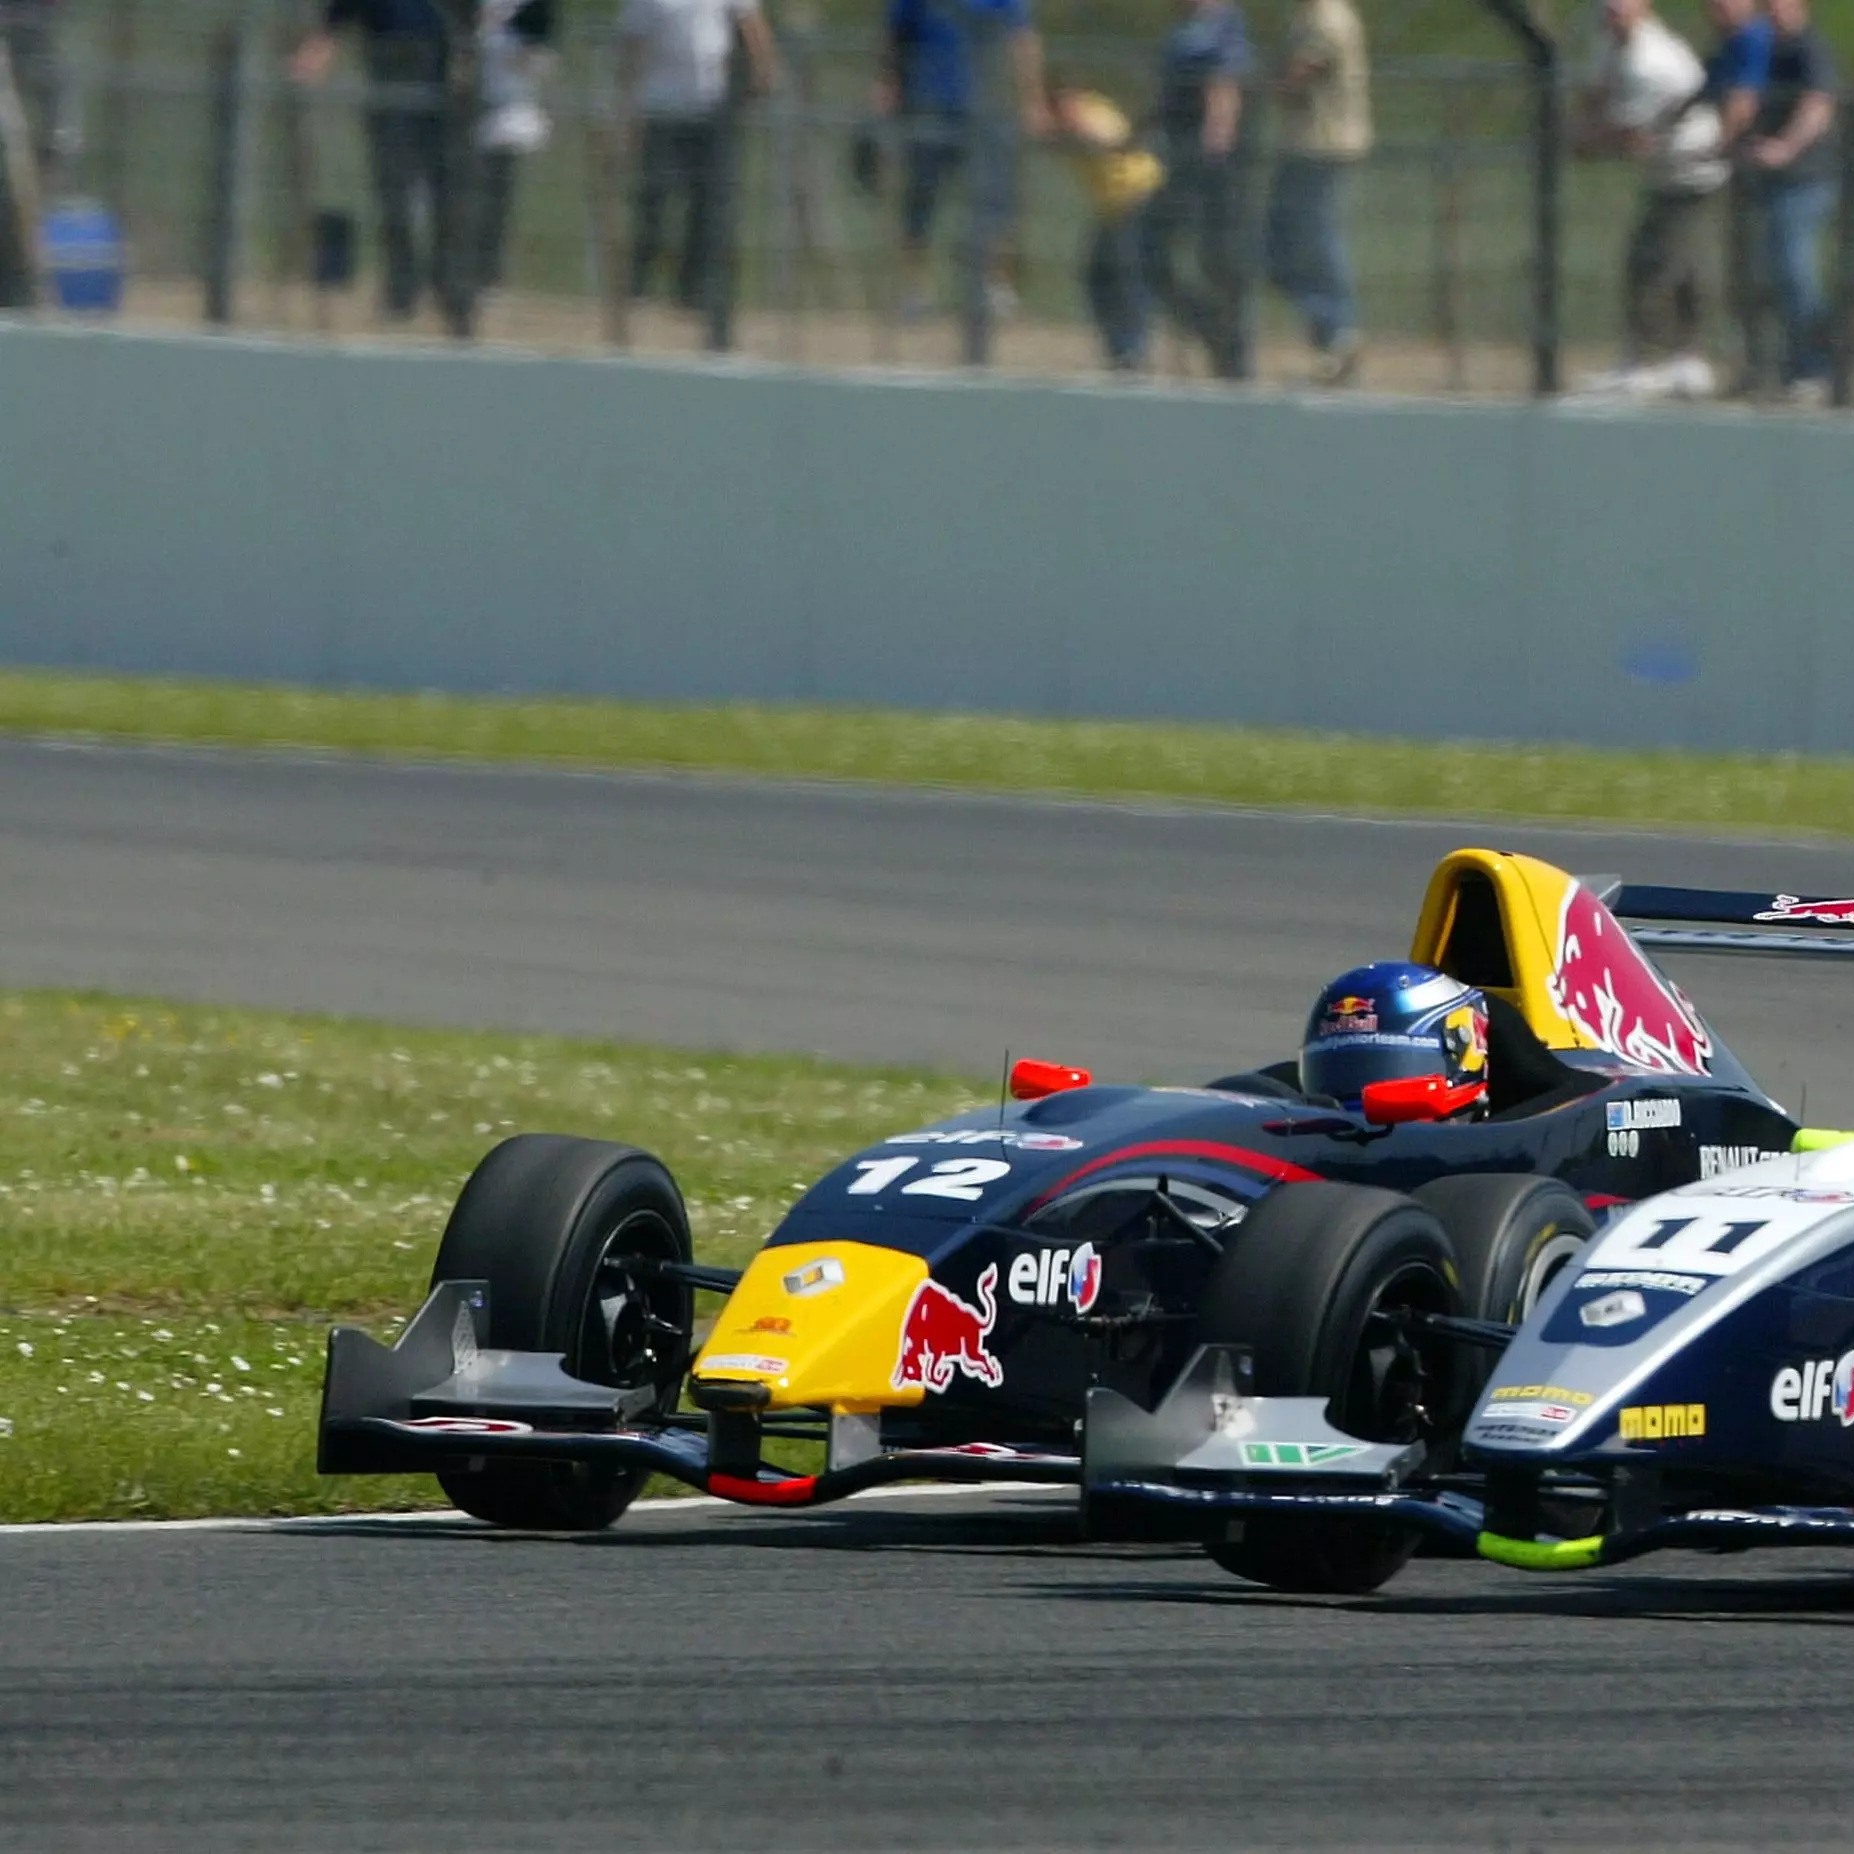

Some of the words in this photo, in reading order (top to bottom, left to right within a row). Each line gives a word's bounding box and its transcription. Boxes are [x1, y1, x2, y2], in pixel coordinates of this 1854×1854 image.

[847, 1156, 1011, 1201] 12
[1634, 1216, 1772, 1256] 11
[1008, 1248, 1070, 1305] elf
[1770, 1359, 1835, 1421] elf
[1618, 1402, 1706, 1440] momo
